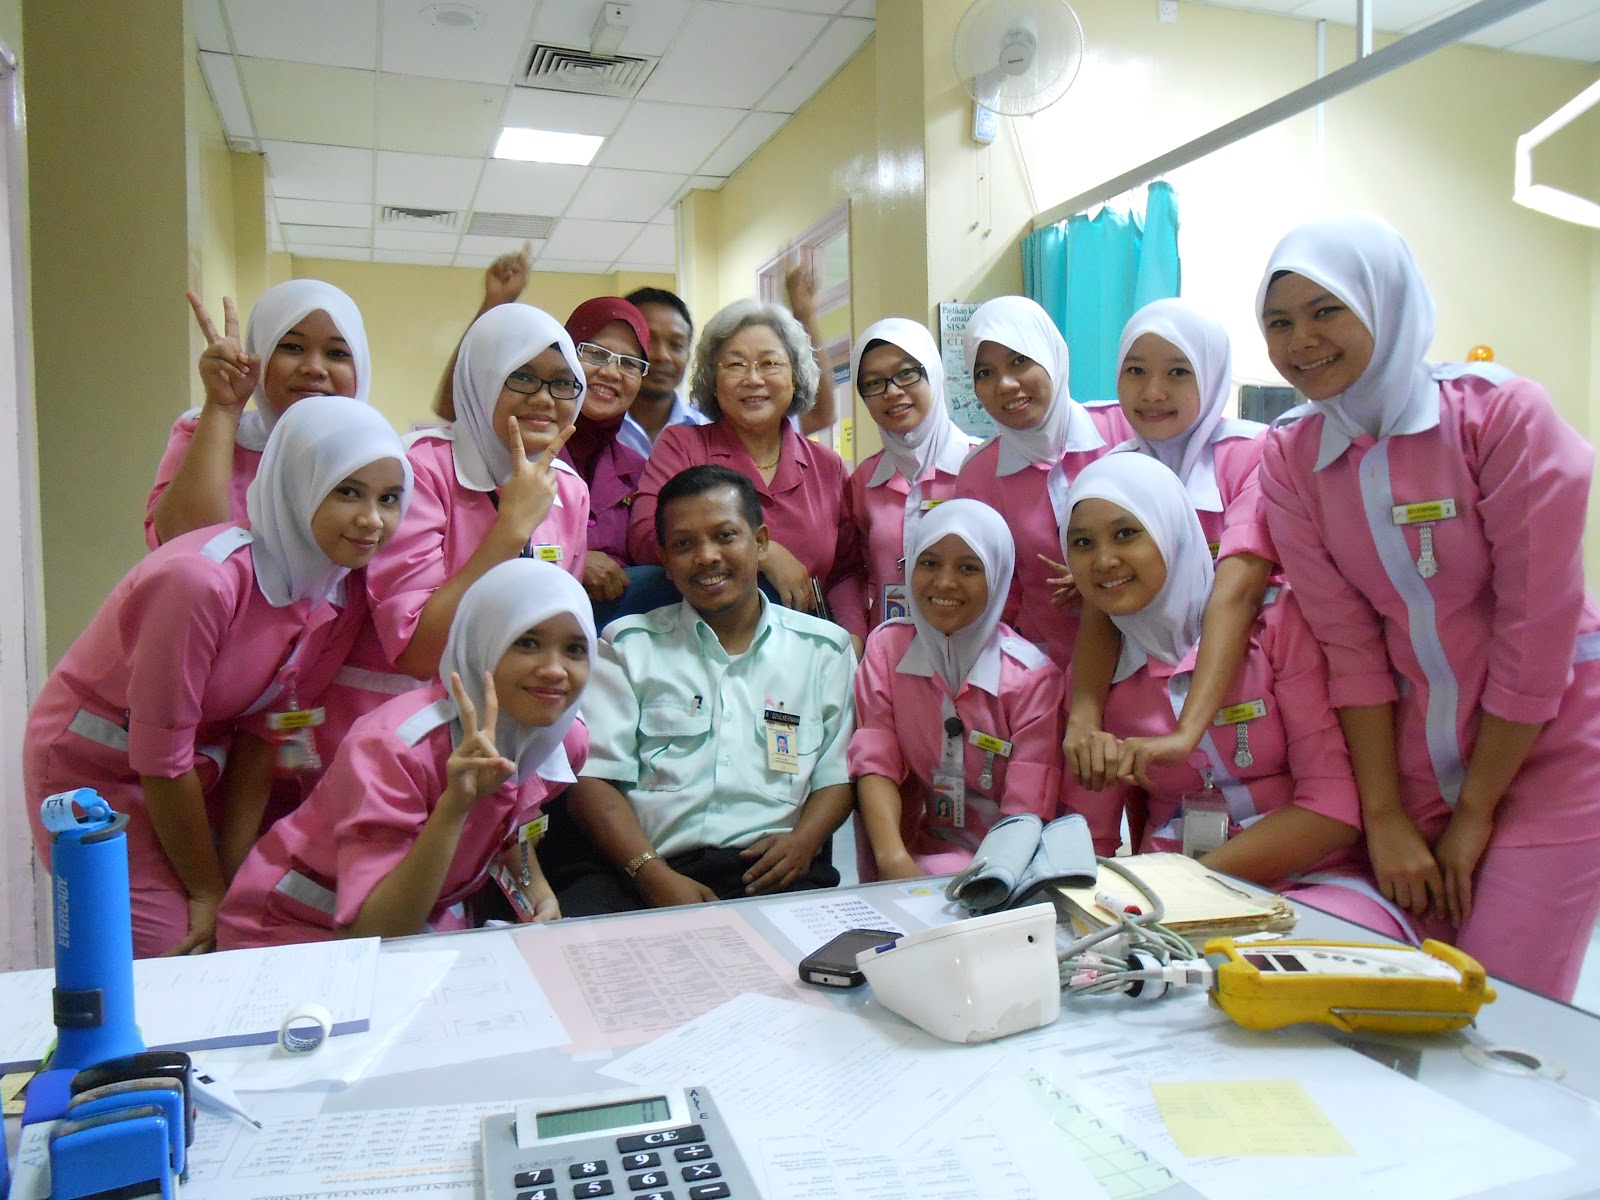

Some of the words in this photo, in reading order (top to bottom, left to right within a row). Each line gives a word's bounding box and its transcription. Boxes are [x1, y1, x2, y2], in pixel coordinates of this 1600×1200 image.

[942, 306, 968, 314] Pastikan
[57, 874, 69, 948] EVEREADY
[644, 1130, 678, 1144] CE
[635, 1154, 649, 1165] 9
[582, 1162, 596, 1172] 8
[529, 1171, 540, 1182] 7
[642, 1172, 656, 1184] 6
[588, 1182, 601, 1192] 5
[531, 1191, 546, 1200] 4
